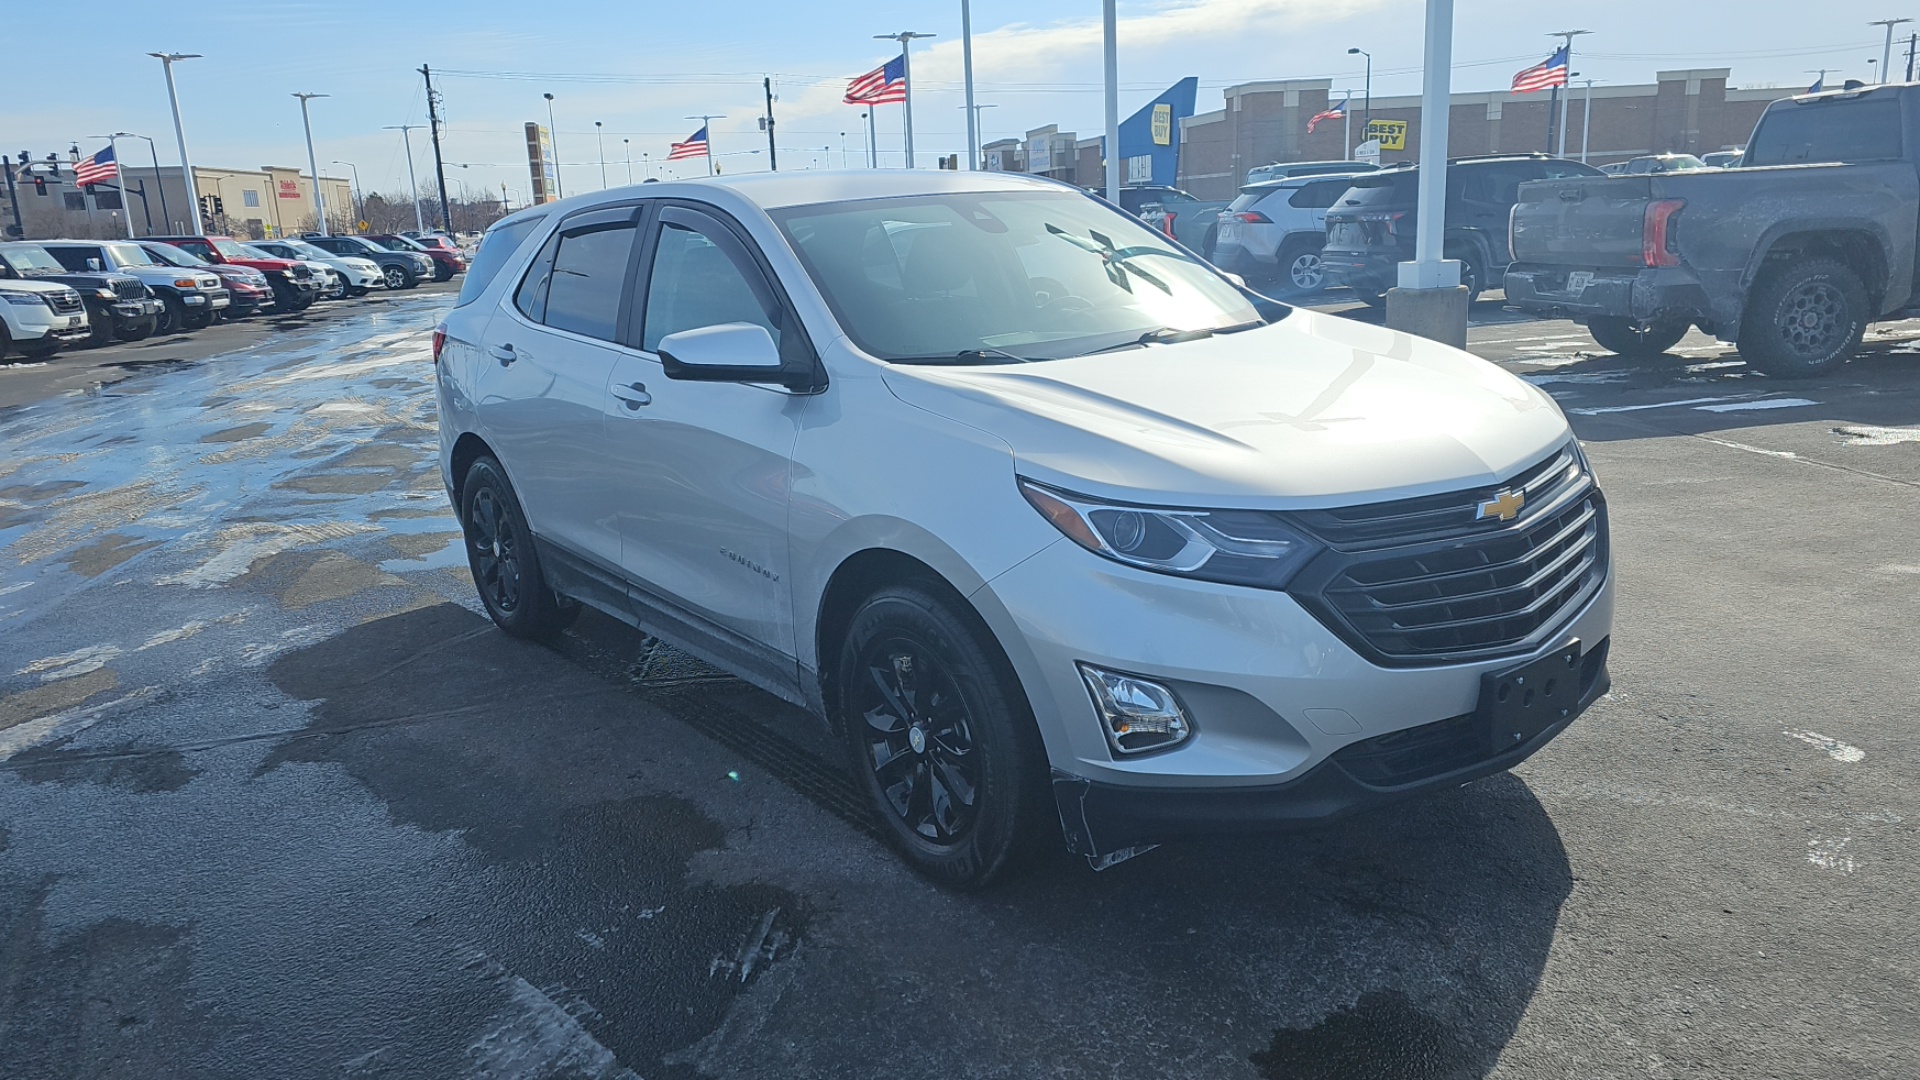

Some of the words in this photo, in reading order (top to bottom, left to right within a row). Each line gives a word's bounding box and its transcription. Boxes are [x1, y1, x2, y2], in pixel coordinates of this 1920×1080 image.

[1154, 111, 1169, 124] BEST
[1154, 125, 1168, 138] BUY
[1368, 124, 1404, 134] BEST
